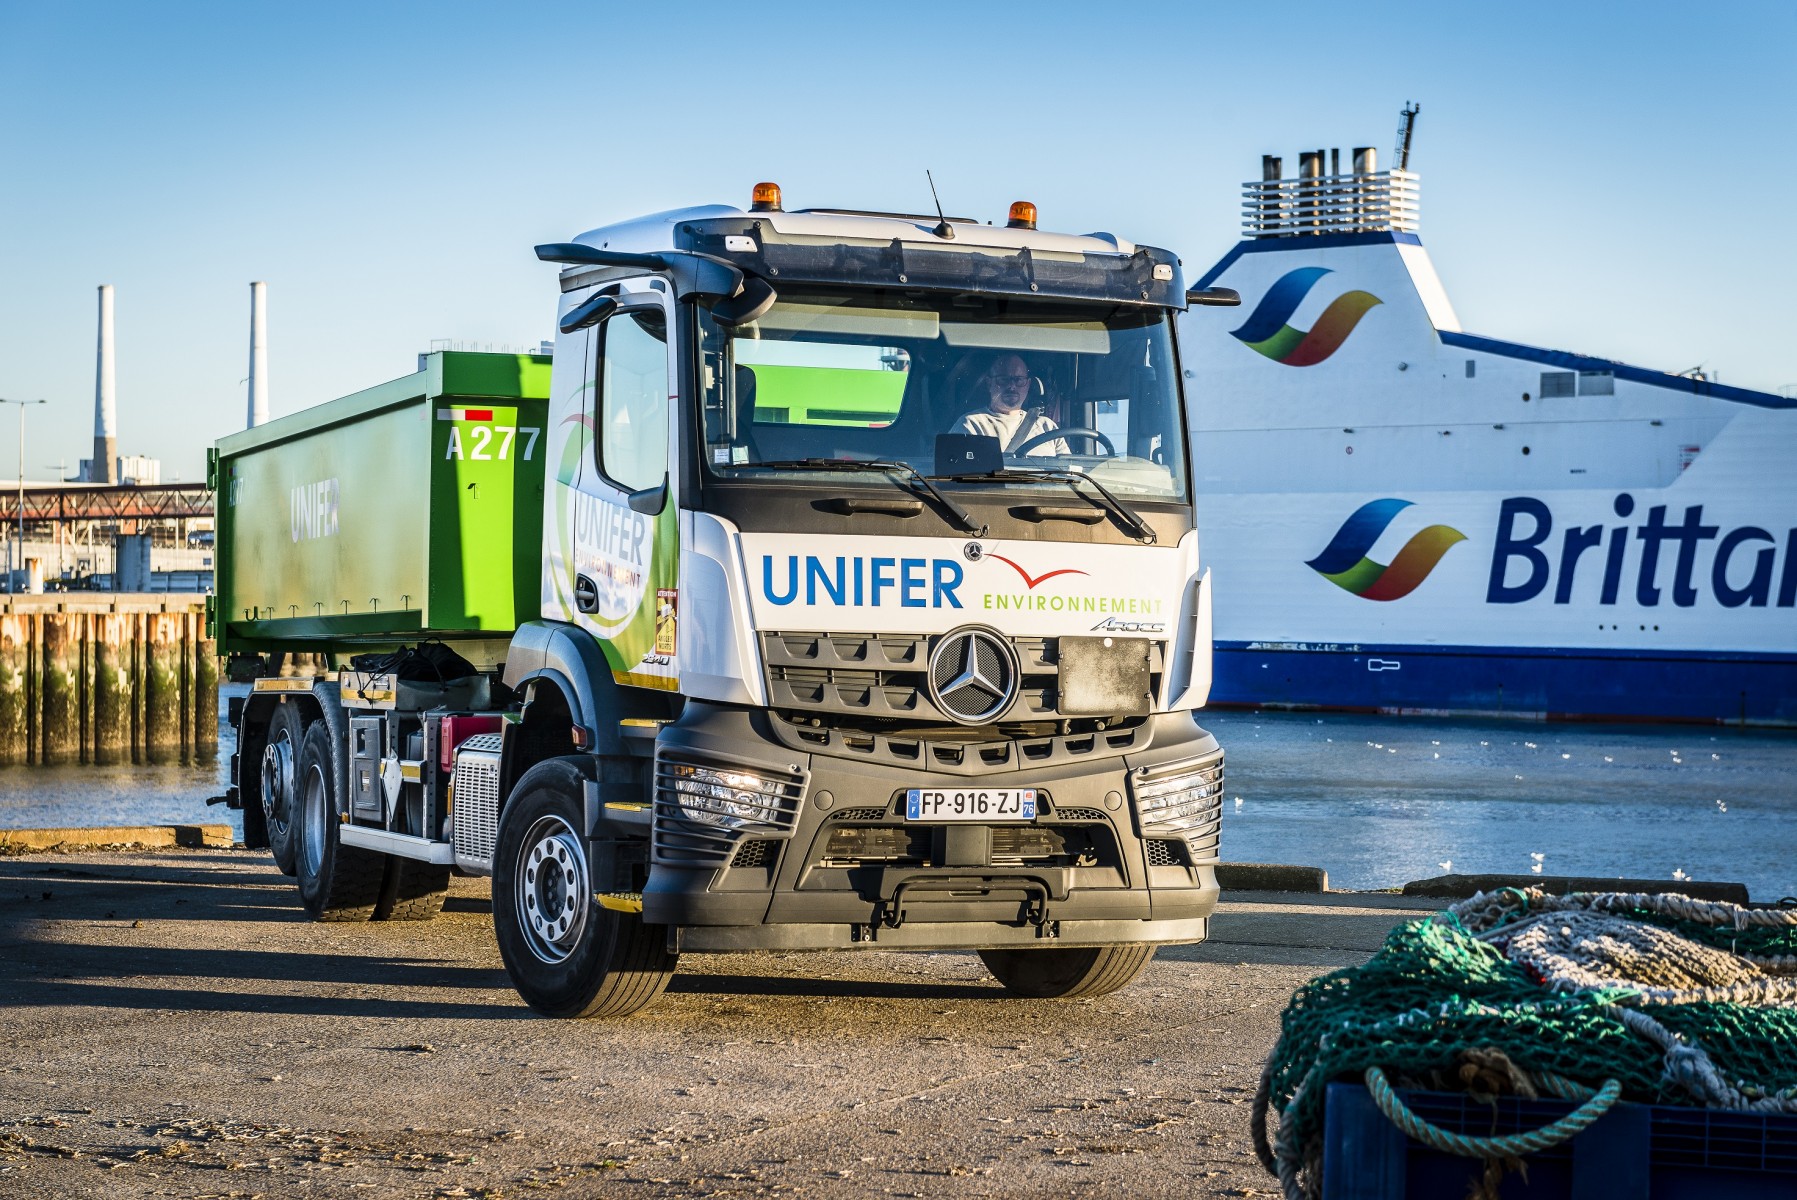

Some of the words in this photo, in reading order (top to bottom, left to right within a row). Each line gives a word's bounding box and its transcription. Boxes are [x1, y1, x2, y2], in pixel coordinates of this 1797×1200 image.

[446, 426, 540, 461] A277
[291, 477, 339, 543] UNIFER
[577, 494, 645, 566] UNIFER
[762, 554, 964, 609] UNIFER
[983, 594, 1162, 614] ENVIRONNEMENT
[921, 792, 1020, 815] FP-916-ZJ
[1023, 803, 1034, 815] 76
